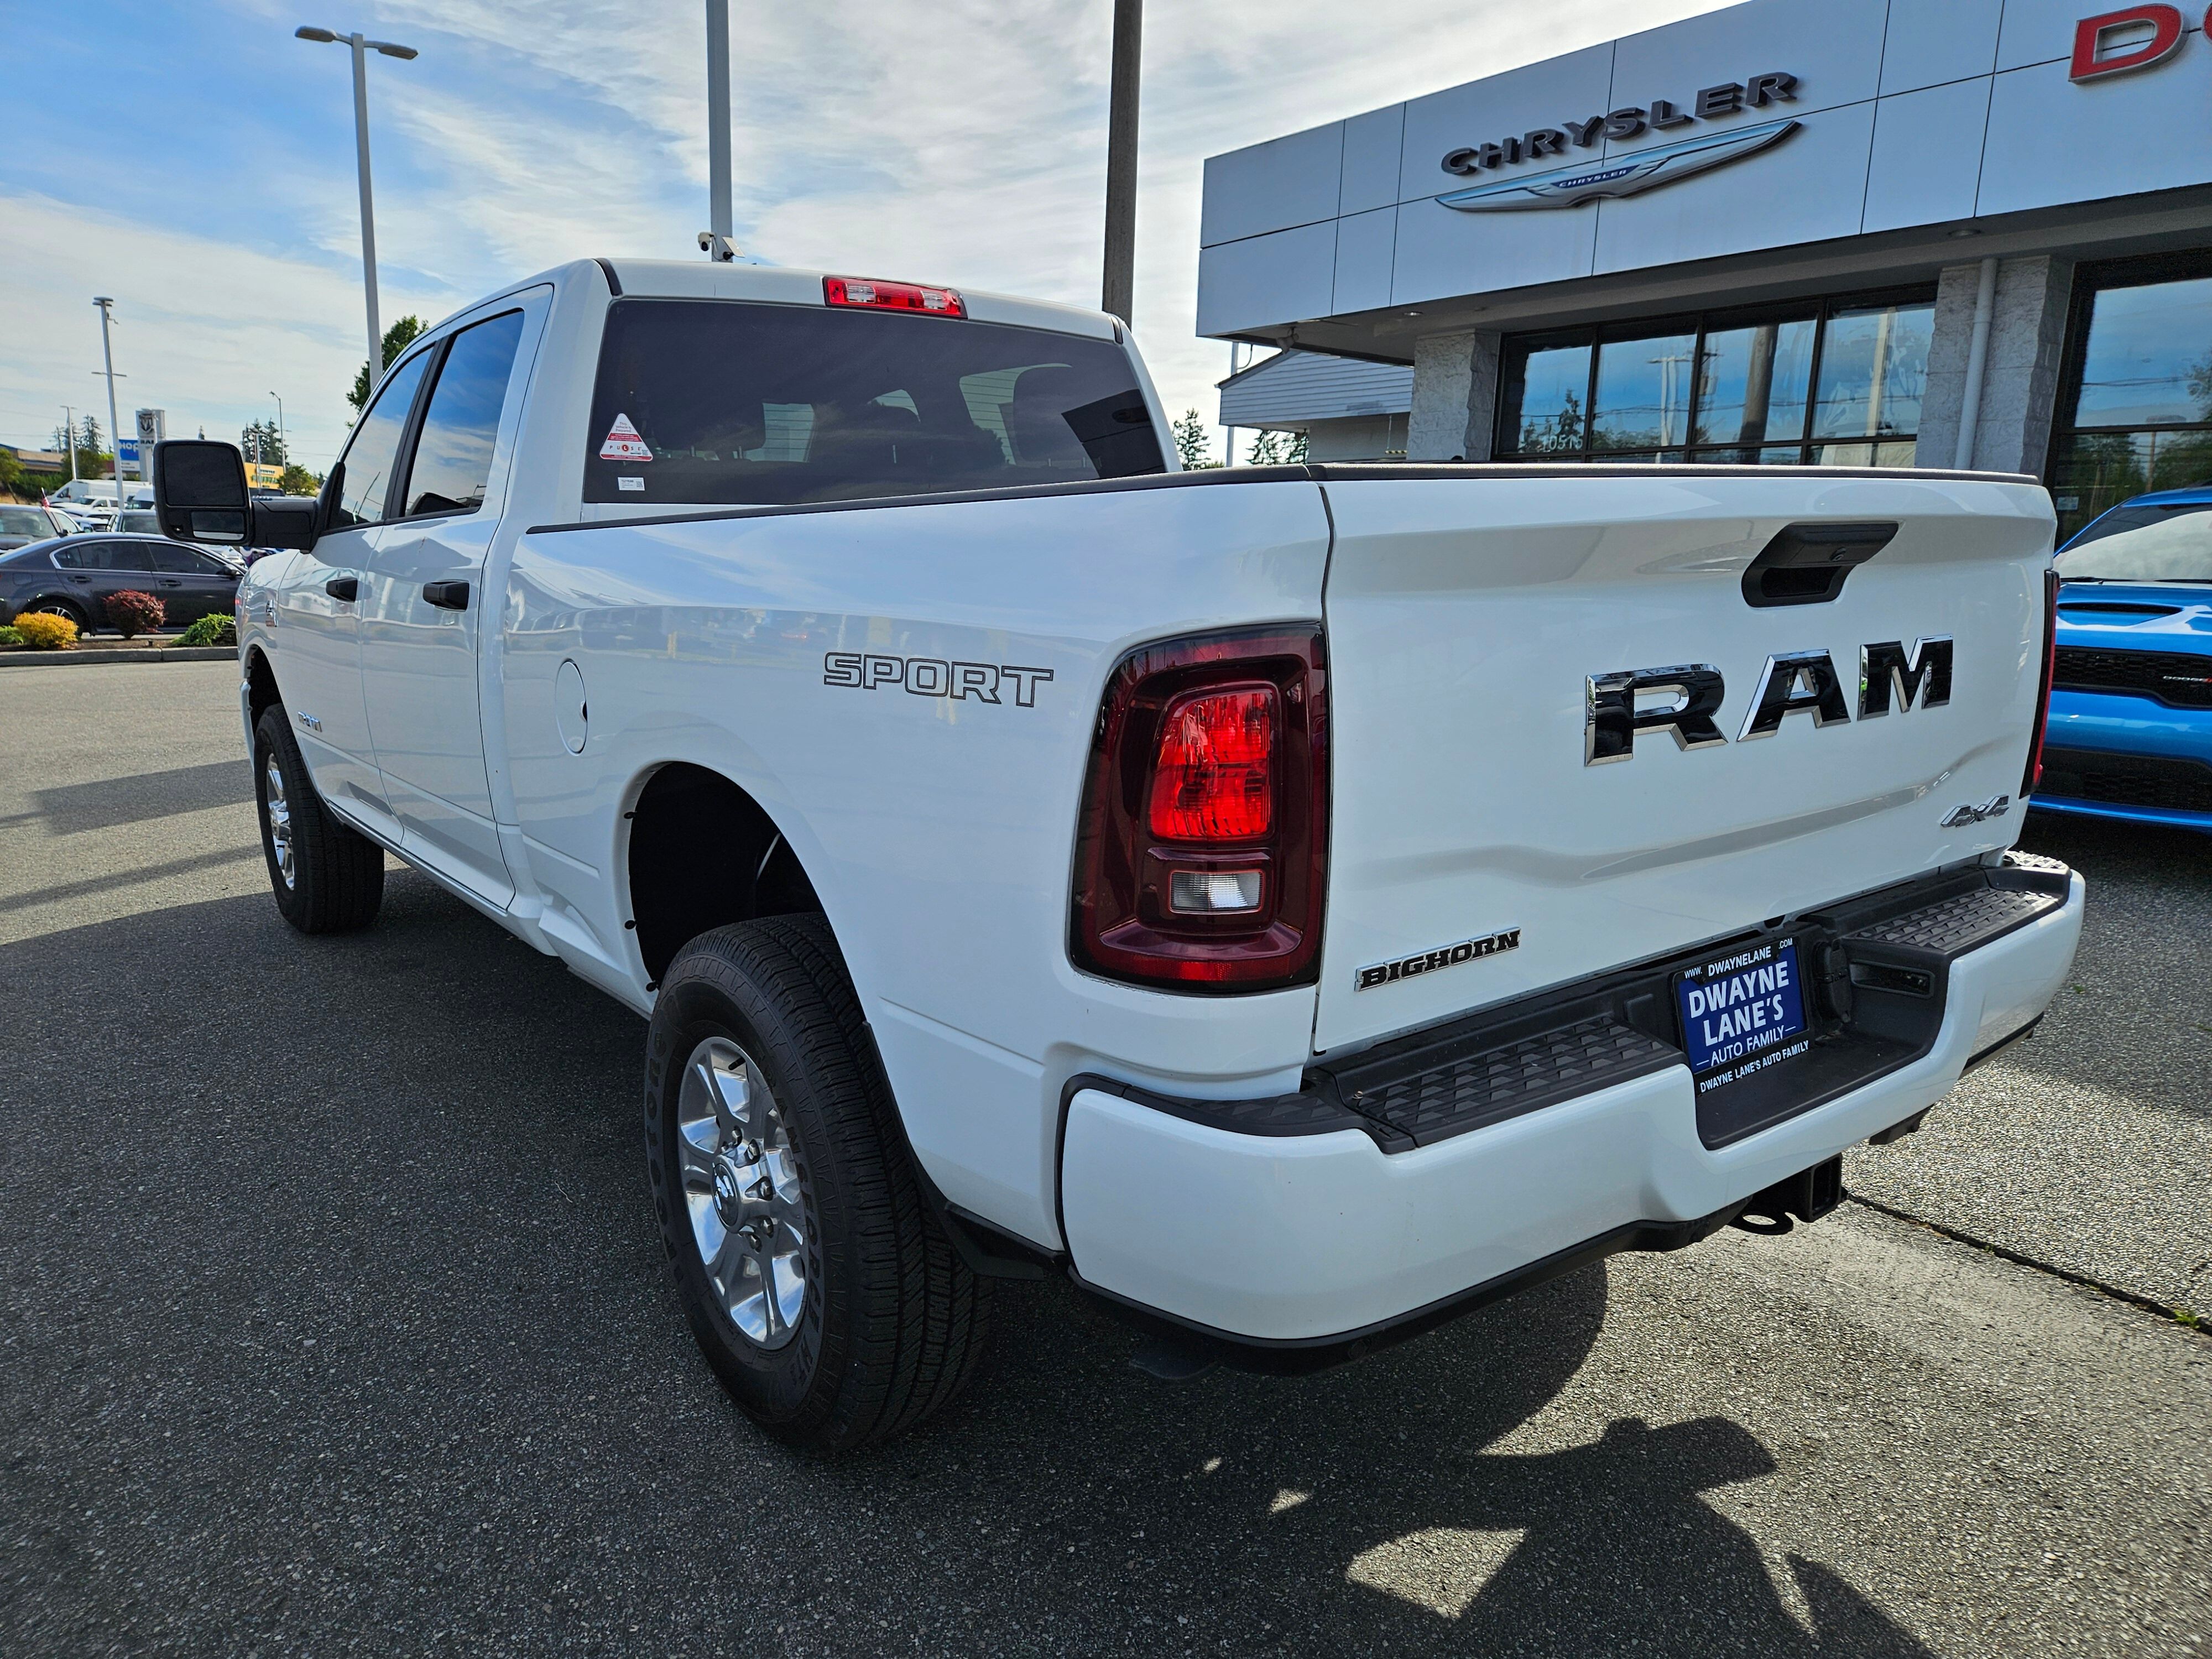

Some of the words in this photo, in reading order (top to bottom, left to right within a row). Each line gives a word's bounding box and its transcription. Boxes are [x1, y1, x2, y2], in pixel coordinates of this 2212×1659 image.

[1441, 72, 1797, 175] CHRYSLER
[1558, 169, 1627, 187] CHRYSLER
[824, 652, 1054, 708] SPORT
[1584, 634, 1954, 767] RAM
[1354, 926, 1521, 992] BIGHORN
[1708, 946, 1771, 977] DWAYNELANE
[1778, 938, 1793, 950] .COM
[1688, 961, 1790, 1019] DWAYNE
[1703, 994, 1784, 1047] LANE'S
[1710, 1041, 1743, 1067] AUTO
[1746, 1025, 1785, 1052] FAMILY
[1700, 1071, 1734, 1093] DWAYNE
[1735, 1060, 1761, 1078] LANE'S
[1762, 1052, 1782, 1068] AUTO
[1782, 1040, 1810, 1059] FAMILY
